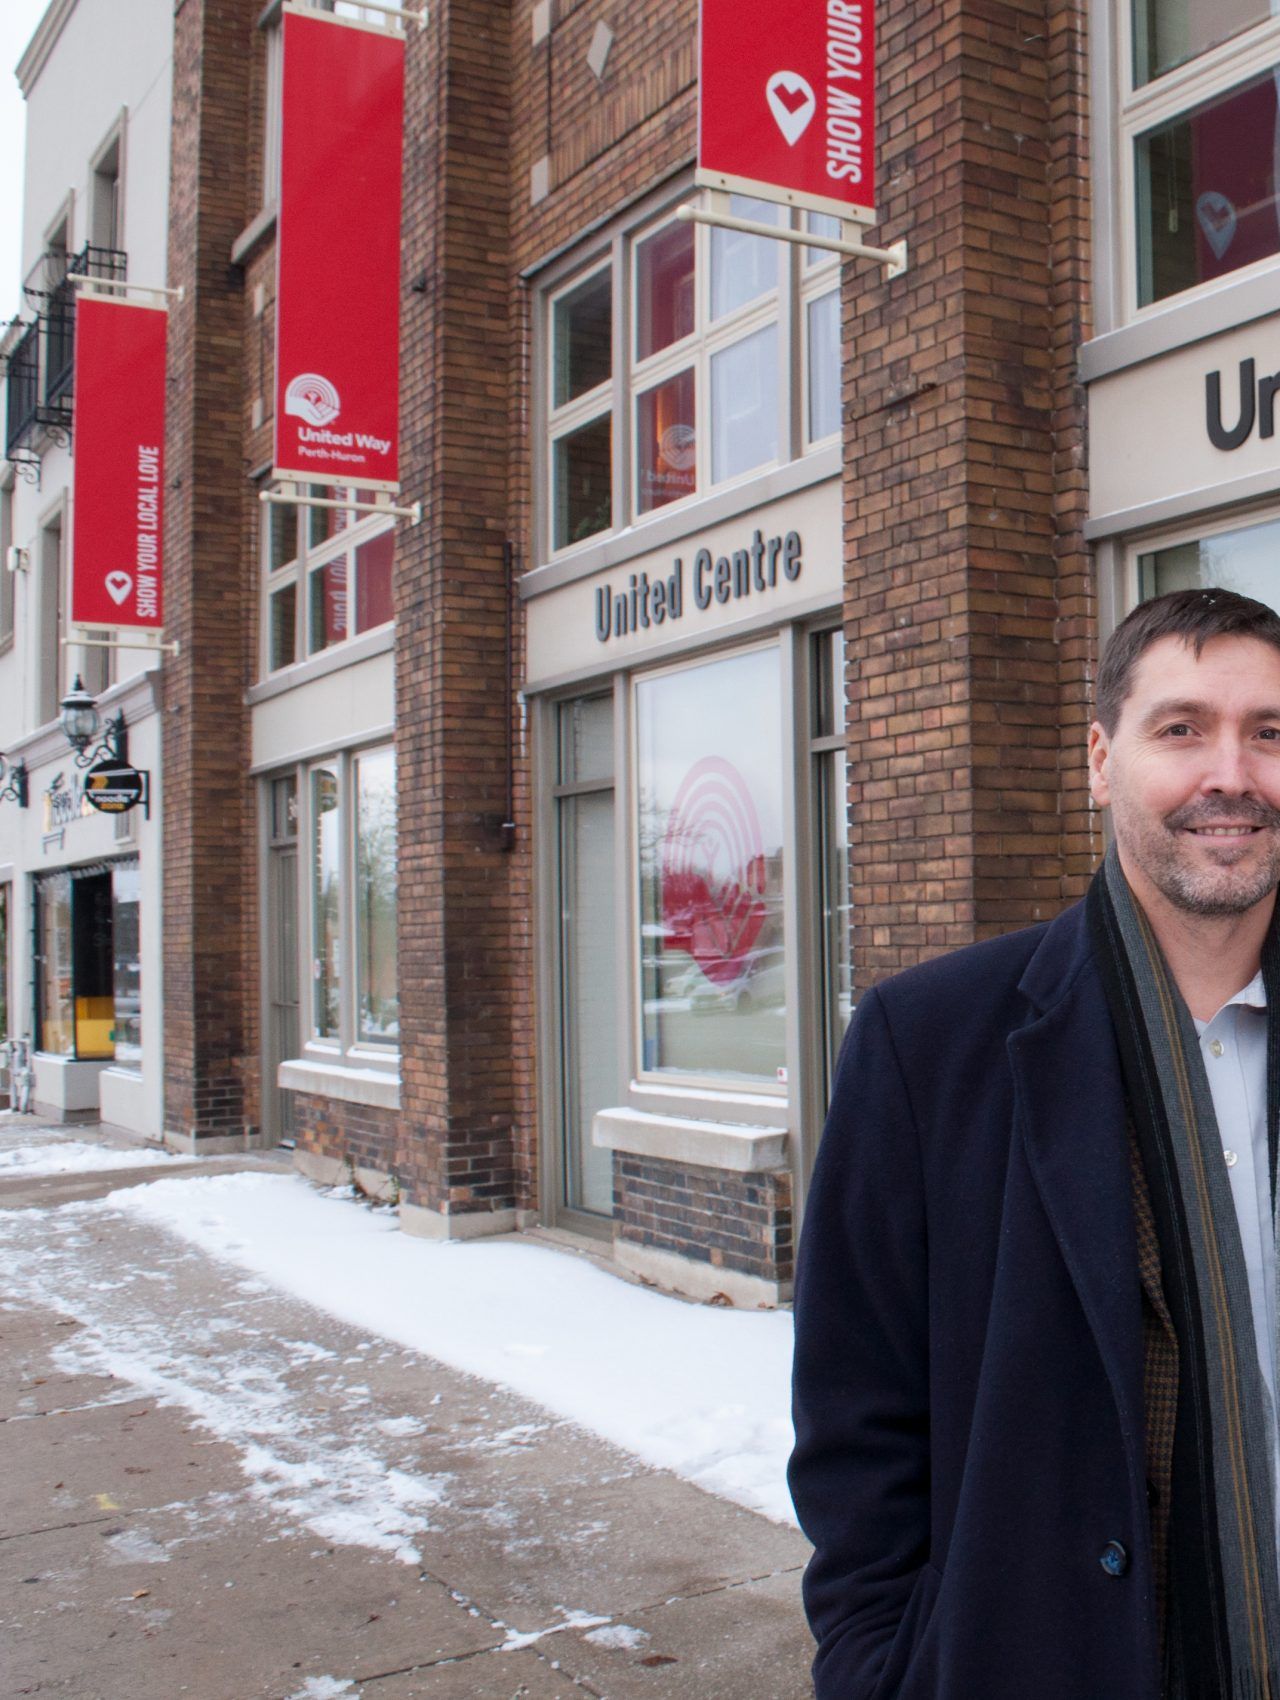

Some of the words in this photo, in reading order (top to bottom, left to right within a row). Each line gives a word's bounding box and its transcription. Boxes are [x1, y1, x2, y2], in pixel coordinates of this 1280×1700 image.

[826, 0, 862, 80] YOUR
[826, 85, 862, 184] SHOW
[297, 426, 354, 447] United
[355, 433, 392, 455] Way
[297, 445, 366, 463] Perth-Huron
[138, 445, 160, 483] LOVE
[137, 486, 160, 531] LOCAL
[136, 534, 159, 571] YOUR
[136, 574, 158, 618] SHOW
[595, 557, 683, 642] United
[693, 529, 802, 610] Centre
